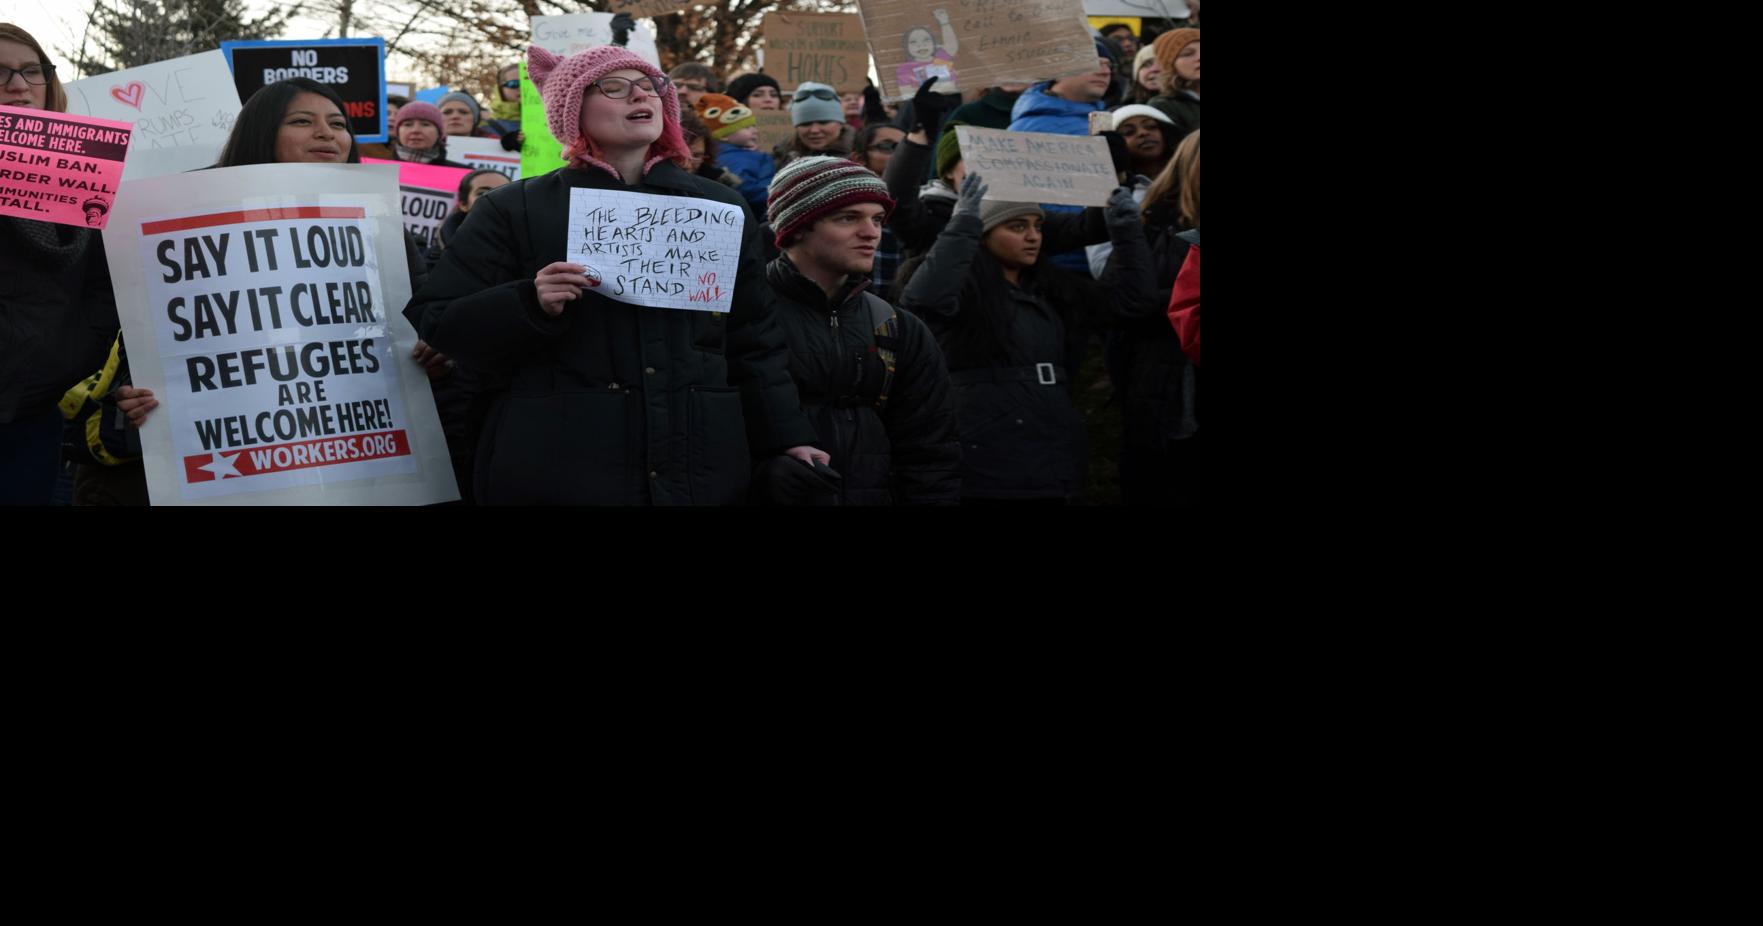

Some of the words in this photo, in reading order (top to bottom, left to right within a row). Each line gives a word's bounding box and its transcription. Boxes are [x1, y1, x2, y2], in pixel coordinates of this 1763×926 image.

[291, 49, 318, 67] NO
[15, 118, 44, 132] AND
[47, 122, 129, 146] IMMIGRANTS
[48, 136, 86, 154] HERE.
[970, 133, 1018, 153] MAKE
[1025, 138, 1096, 155] AMERICA
[56, 158, 102, 174] BAN.
[977, 154, 1111, 175] COMPASSIONATE
[58, 178, 116, 195] WALL.
[1023, 173, 1074, 189] AGAIN
[401, 195, 448, 220] LOUD
[586, 207, 617, 224] THE
[631, 206, 736, 227] BLEEDING
[584, 226, 655, 243] HEARTS
[667, 228, 706, 243] AND
[156, 233, 230, 284] SAY
[243, 228, 280, 273] IT
[290, 225, 366, 269] LOUD
[581, 242, 643, 258] ARTISTS
[665, 248, 721, 263] MAKE
[620, 258, 691, 277] THEIR
[697, 271, 716, 285] NO
[614, 274, 685, 296] STAND
[167, 290, 240, 342] SAY
[246, 286, 283, 332] IT
[290, 281, 377, 327] CLEAR
[186, 338, 381, 393] REFUGEES
[278, 380, 328, 406] ARE
[194, 405, 335, 451] WELCOME
[336, 398, 394, 433] HERE!
[249, 433, 396, 471] WORKERS.ORG
